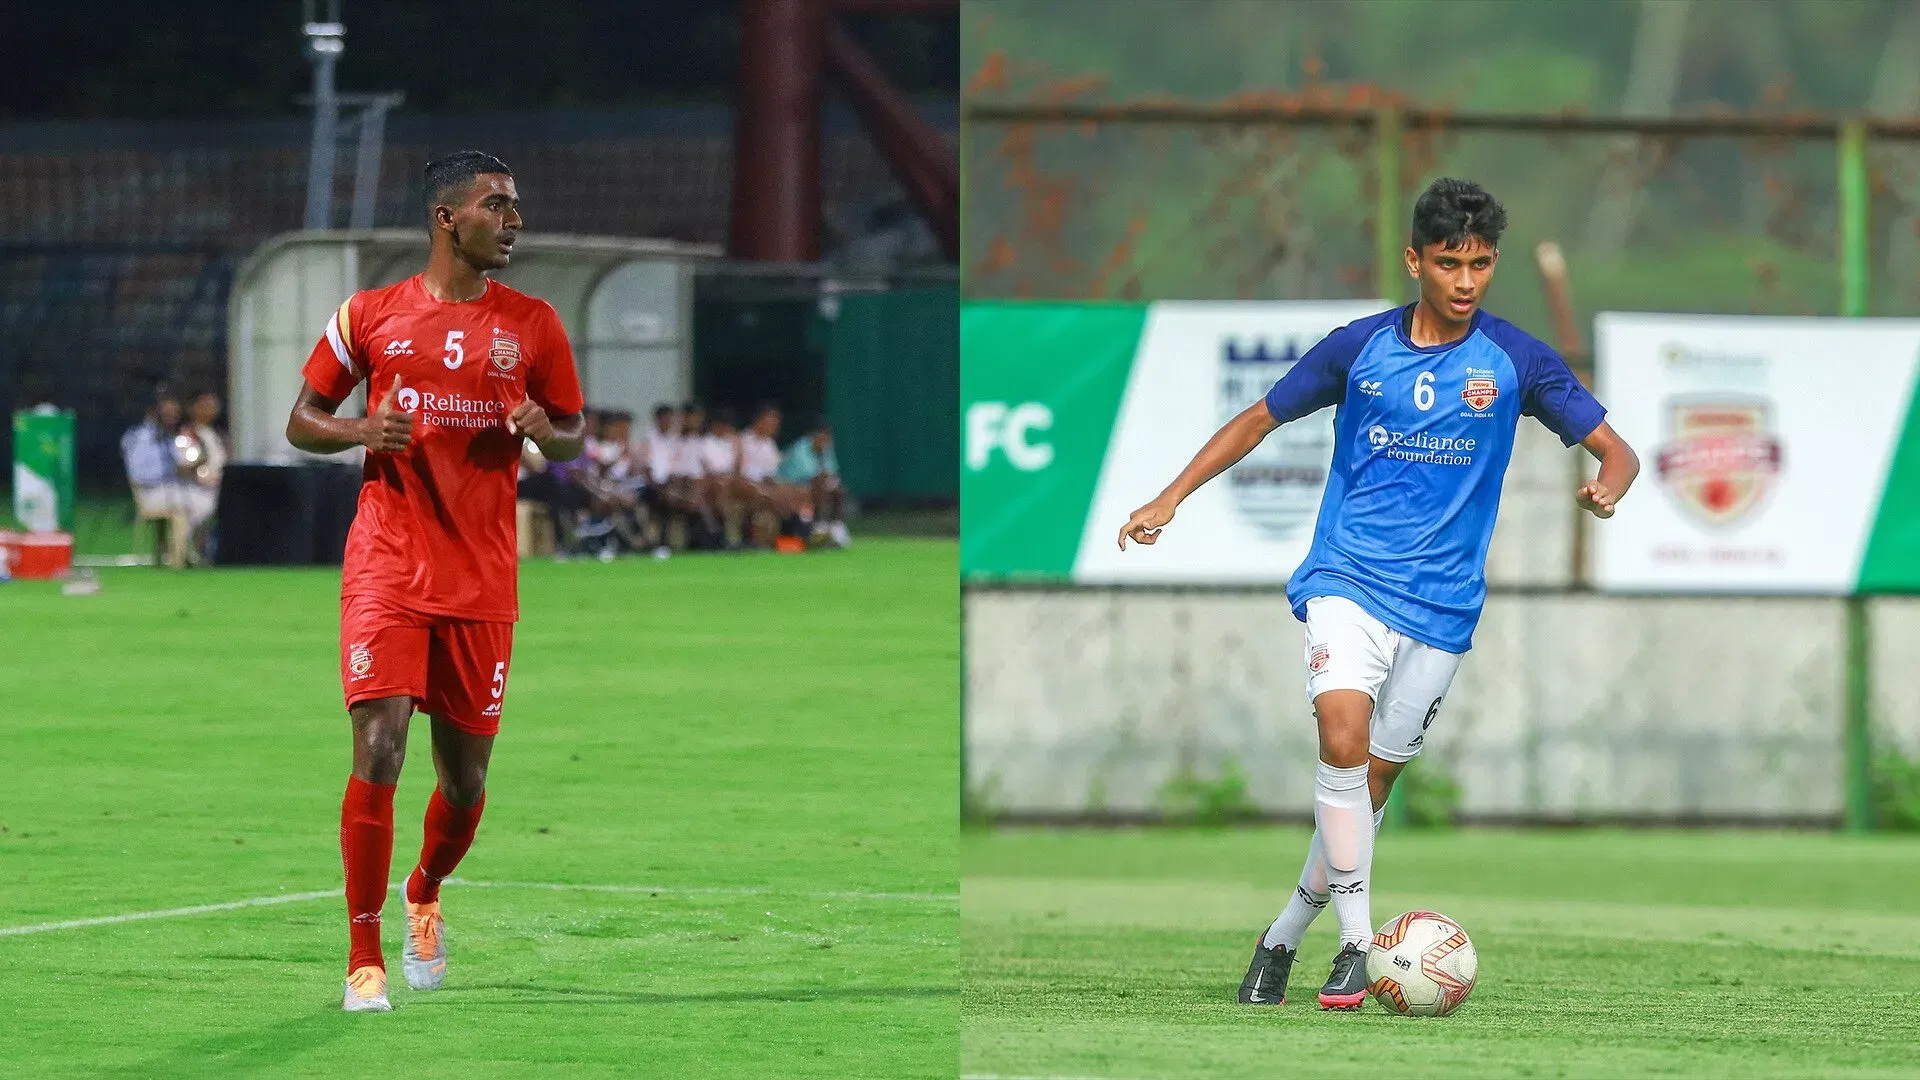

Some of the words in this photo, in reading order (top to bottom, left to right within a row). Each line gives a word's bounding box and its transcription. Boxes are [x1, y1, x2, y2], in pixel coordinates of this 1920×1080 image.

[443, 330, 465, 370] 5
[493, 350, 518, 358] CHAMPS
[422, 392, 505, 413] Reliance
[1413, 371, 1436, 411] 6
[1466, 389, 1494, 397] CHAMPS
[964, 401, 1054, 471] FC
[1388, 431, 1476, 451] Reliance
[1387, 447, 1472, 465] Foundation
[491, 661, 505, 699] 5
[1422, 696, 1443, 731] 6
